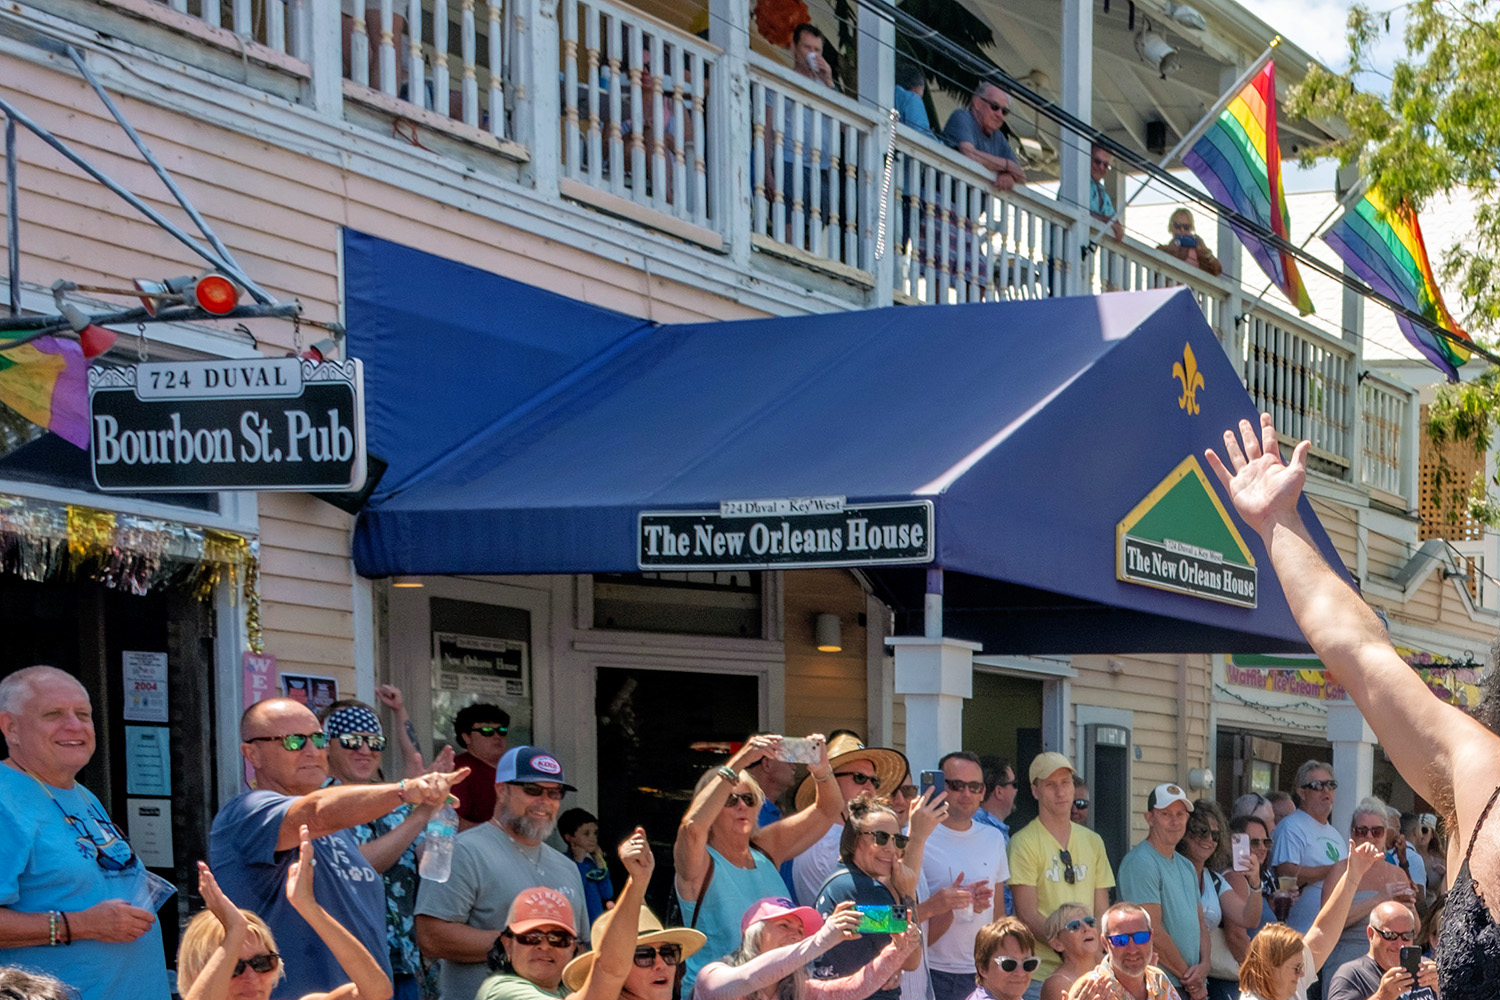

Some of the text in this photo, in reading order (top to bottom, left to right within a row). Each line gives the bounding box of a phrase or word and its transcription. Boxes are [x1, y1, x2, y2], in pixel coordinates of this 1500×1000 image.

[151, 366, 287, 389] 724 DUVAL
[94, 408, 353, 465] Bourbon St. Pub
[723, 500, 841, 514] 724 Duval Key West
[644, 517, 925, 557] The New Orleans House
[1127, 546, 1255, 598] The New Orleans House
[1273, 673, 1287, 690] Ice
[1289, 675, 1321, 695] Cream
